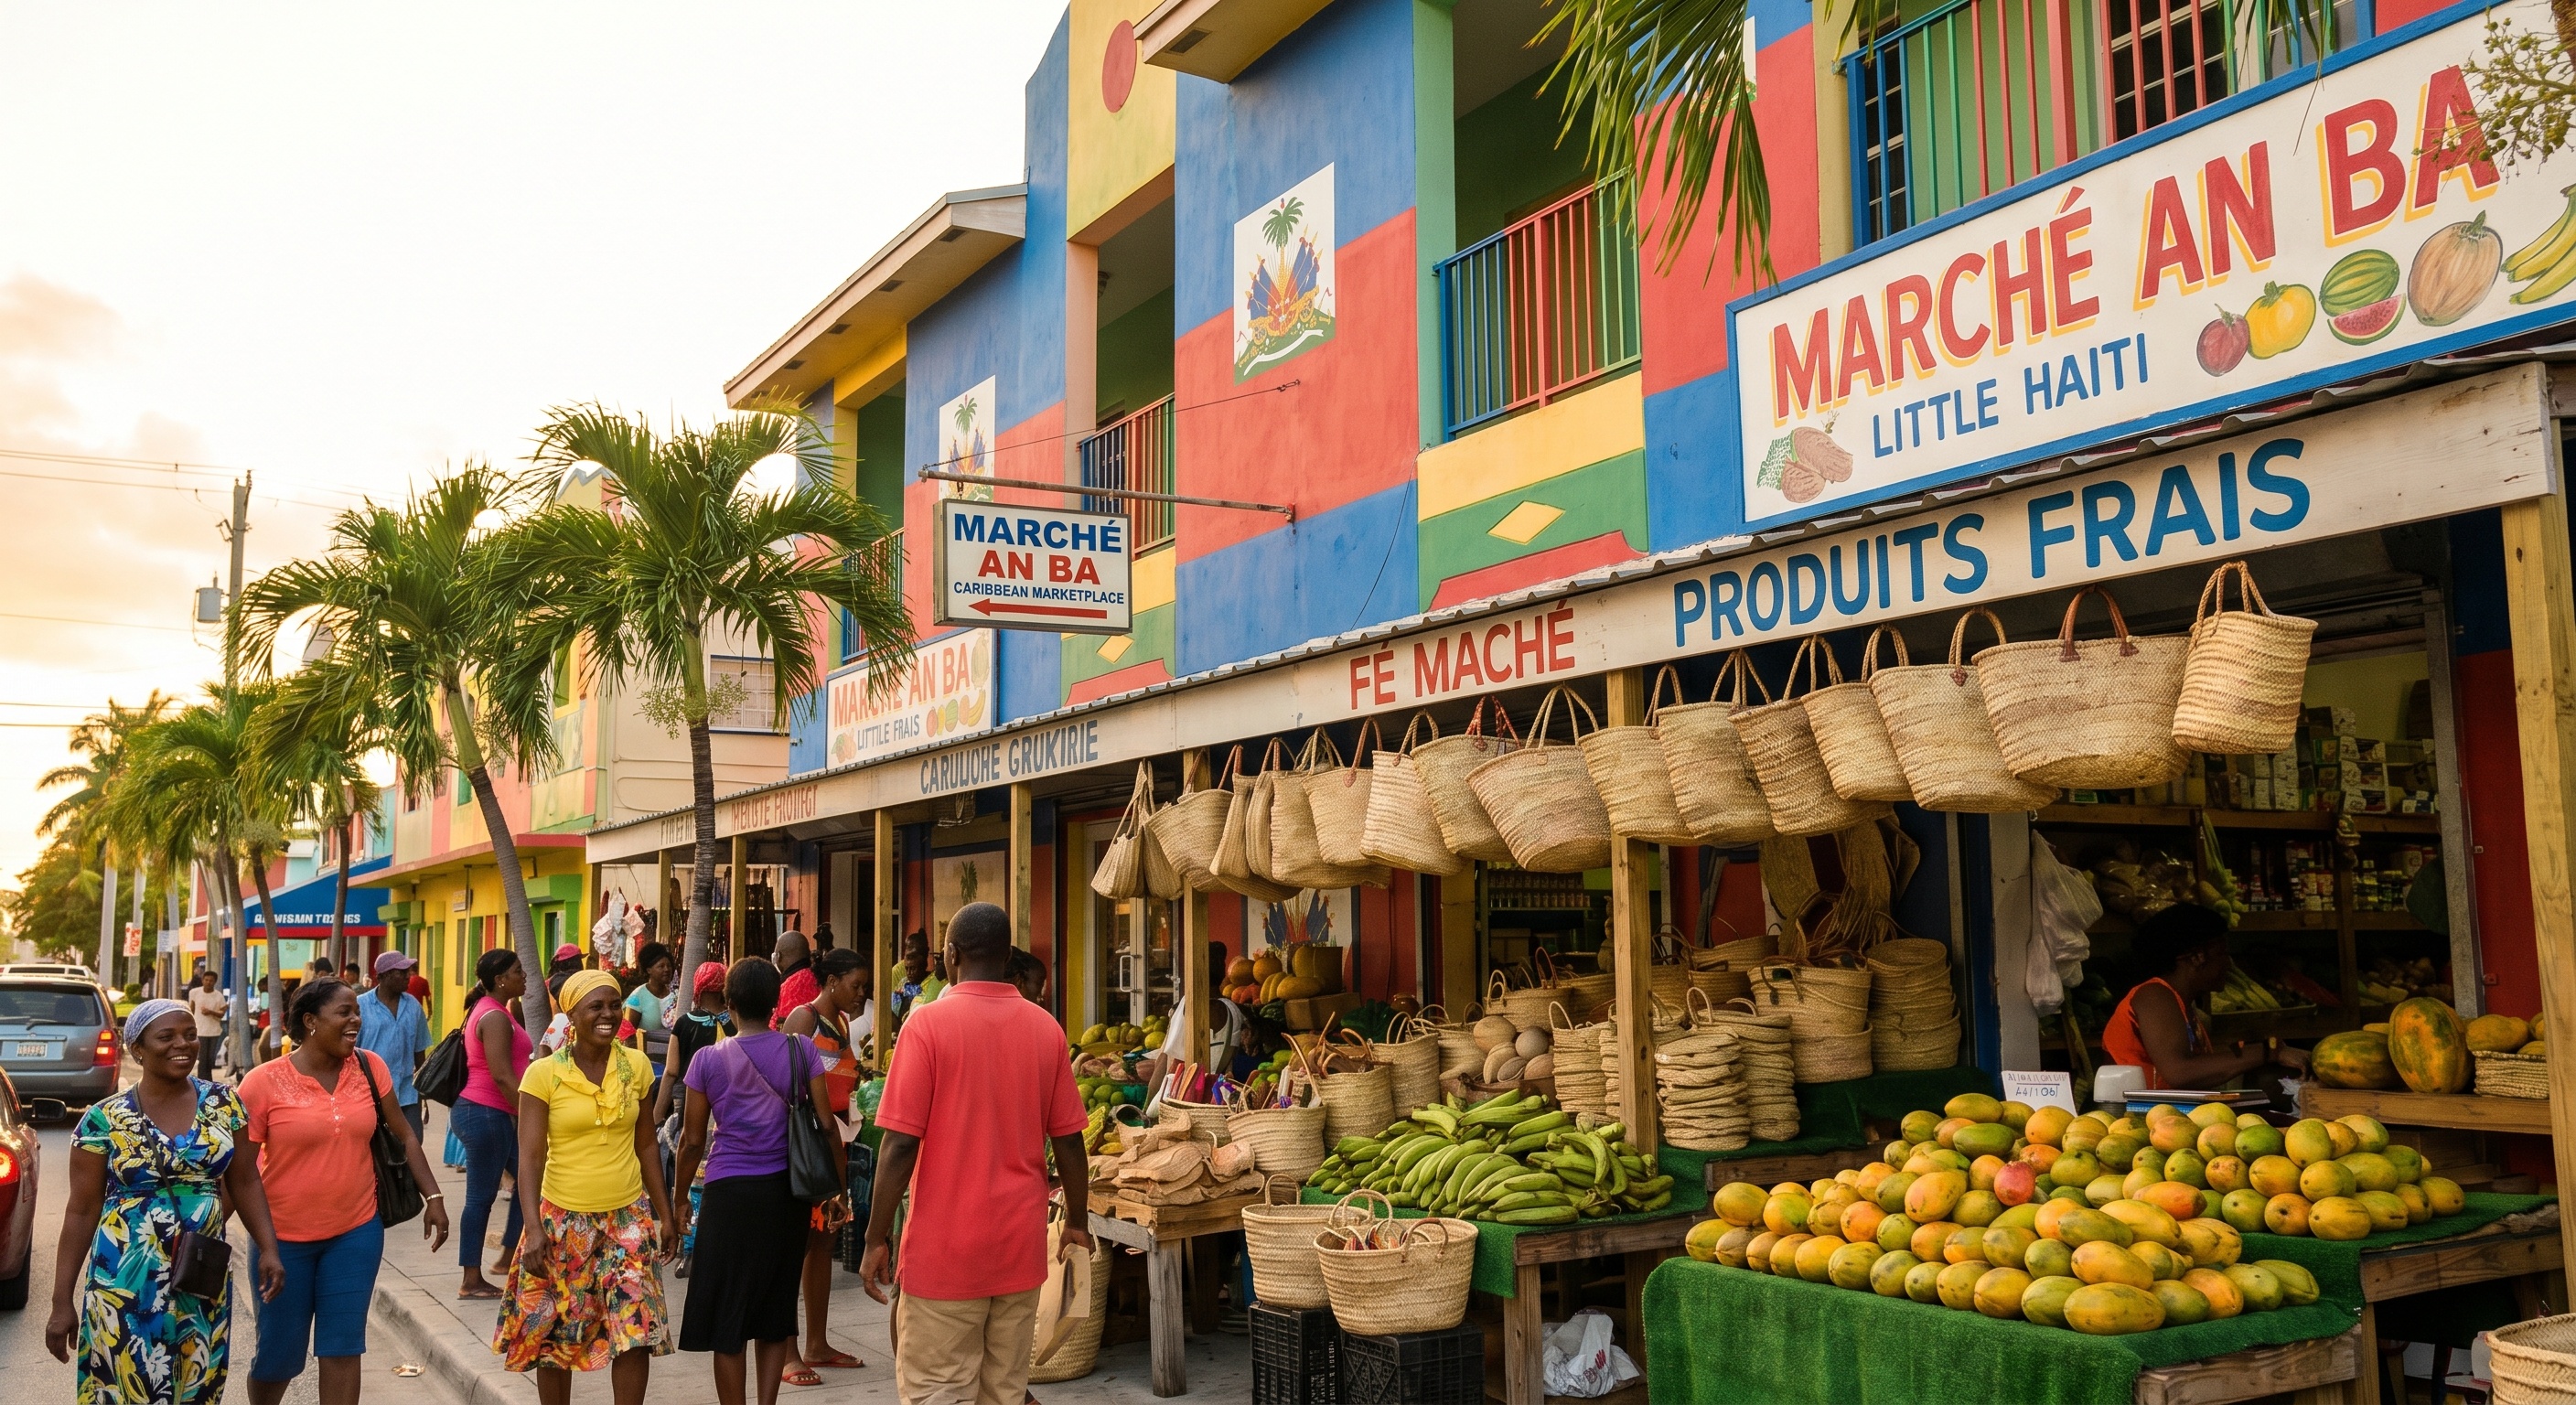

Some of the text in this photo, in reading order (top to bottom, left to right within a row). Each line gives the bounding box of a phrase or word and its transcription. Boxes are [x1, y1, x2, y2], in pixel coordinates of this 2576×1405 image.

[1773, 64, 2500, 419] MARCHÉ AN BA
[1873, 333, 2149, 457] LITTLE HAITI
[954, 513, 1122, 553] MARCHÉ
[1676, 438, 2310, 648] PRODUITS FRAIS
[953, 582, 1124, 605] CARIBBEAN MARKETPLACE
[977, 550, 1101, 585] AN BA
[908, 652, 936, 706] AN
[942, 642, 971, 696] BA
[1350, 599, 1575, 710] FÉ MACHÉ
[893, 713, 920, 742] FRAIS
[1008, 719, 1099, 778] GRUKIRIE
